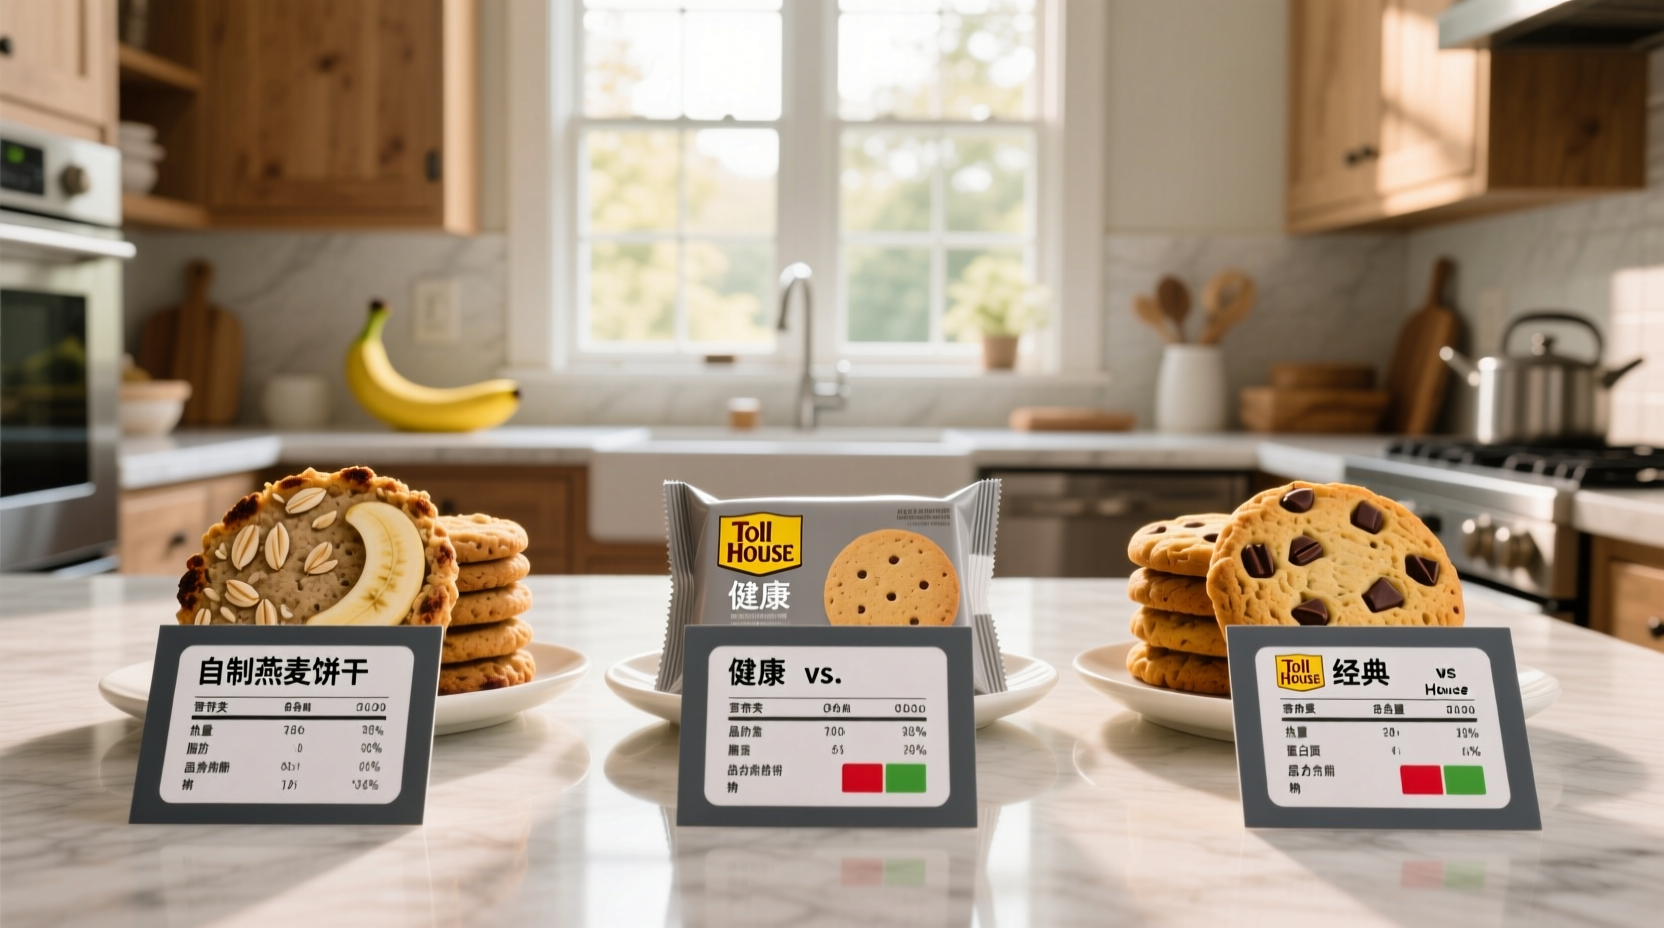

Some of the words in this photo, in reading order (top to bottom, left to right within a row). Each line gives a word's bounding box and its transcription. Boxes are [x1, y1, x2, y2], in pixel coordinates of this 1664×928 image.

[732, 521, 772, 543] Toll
[727, 543, 794, 563] HOUSE
[728, 579, 791, 611] 健康
[199, 656, 369, 687] 自制燕麦饼干
[728, 657, 786, 687] 健康
[804, 667, 842, 684] vs.
[1281, 659, 1310, 673] Toll
[1281, 672, 1321, 685] HOUSE
[1332, 658, 1390, 686] 经典
